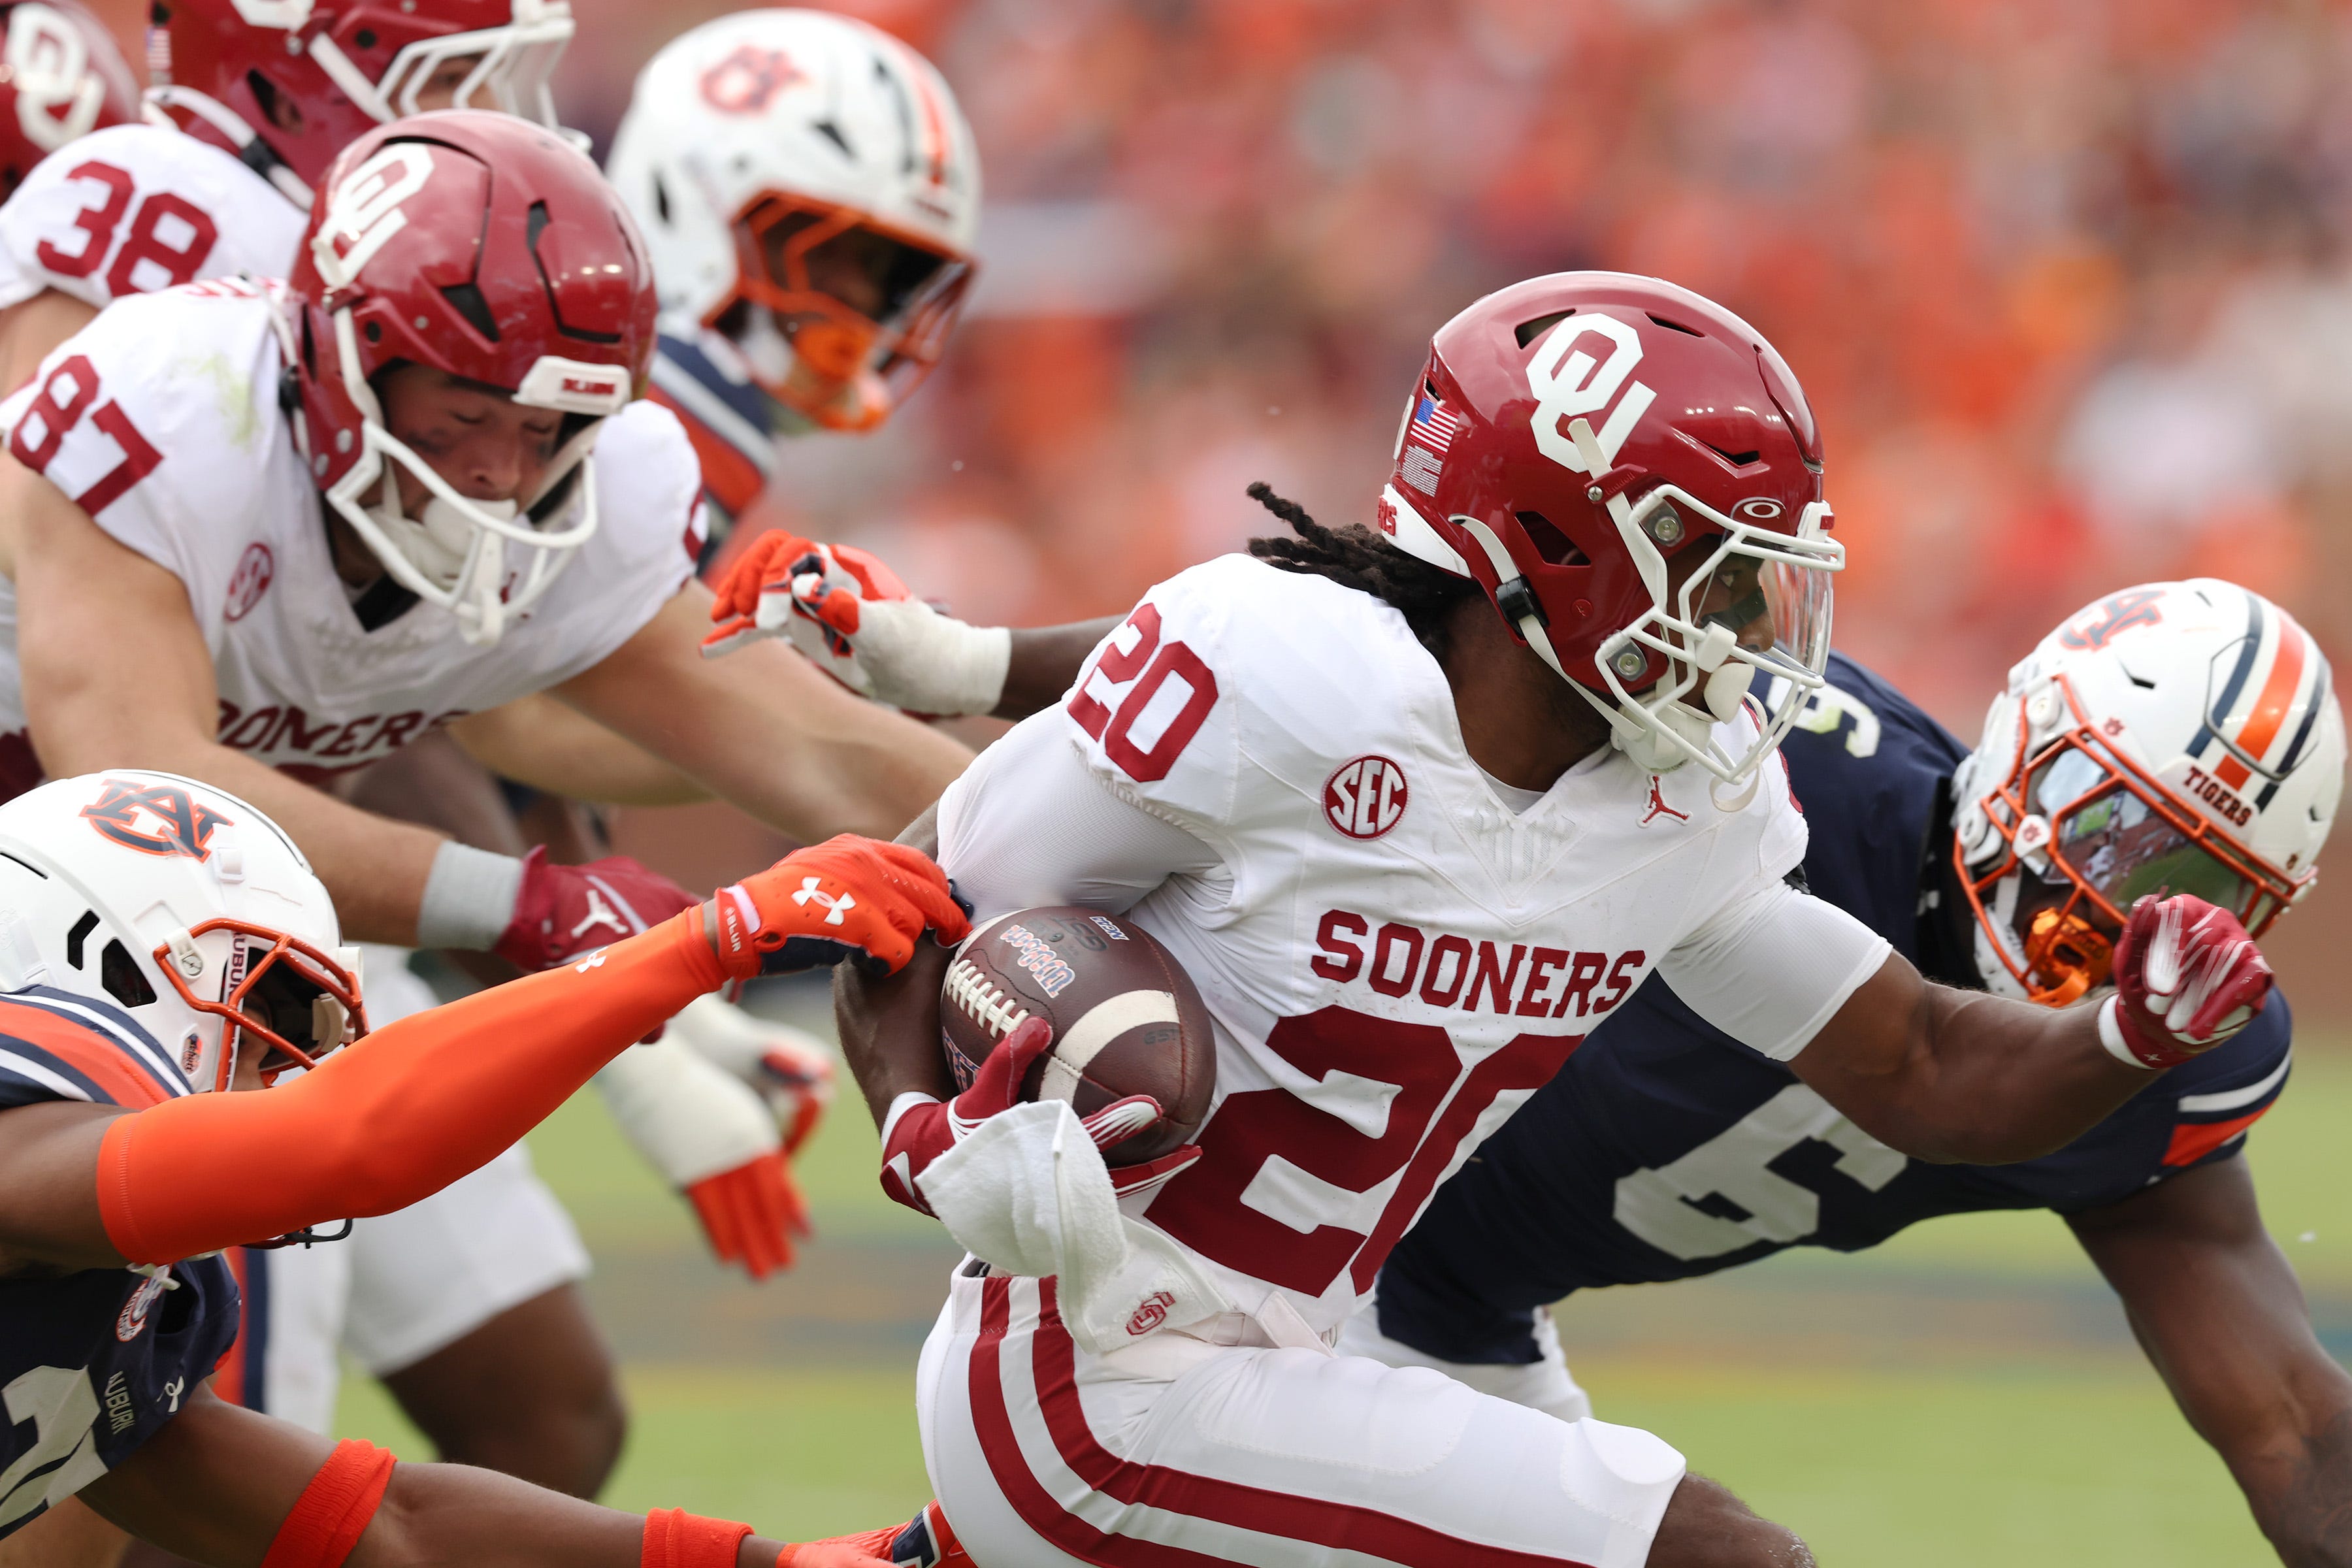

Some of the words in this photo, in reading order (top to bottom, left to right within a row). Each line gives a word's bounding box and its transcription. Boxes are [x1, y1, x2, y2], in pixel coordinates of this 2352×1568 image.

[37, 160, 218, 299] 38
[1525, 312, 1658, 474] OU
[10, 355, 165, 519] 87
[1067, 602, 1218, 783] 20
[78, 779, 234, 864] AU
[1326, 755, 1409, 838] SEC
[2182, 766, 2253, 828] TIGERS
[1000, 924, 1077, 999] Wilson
[1089, 915, 1130, 941] NCAA
[1311, 908, 1646, 1019] SOONERS
[103, 1370, 135, 1435] AUBURN
